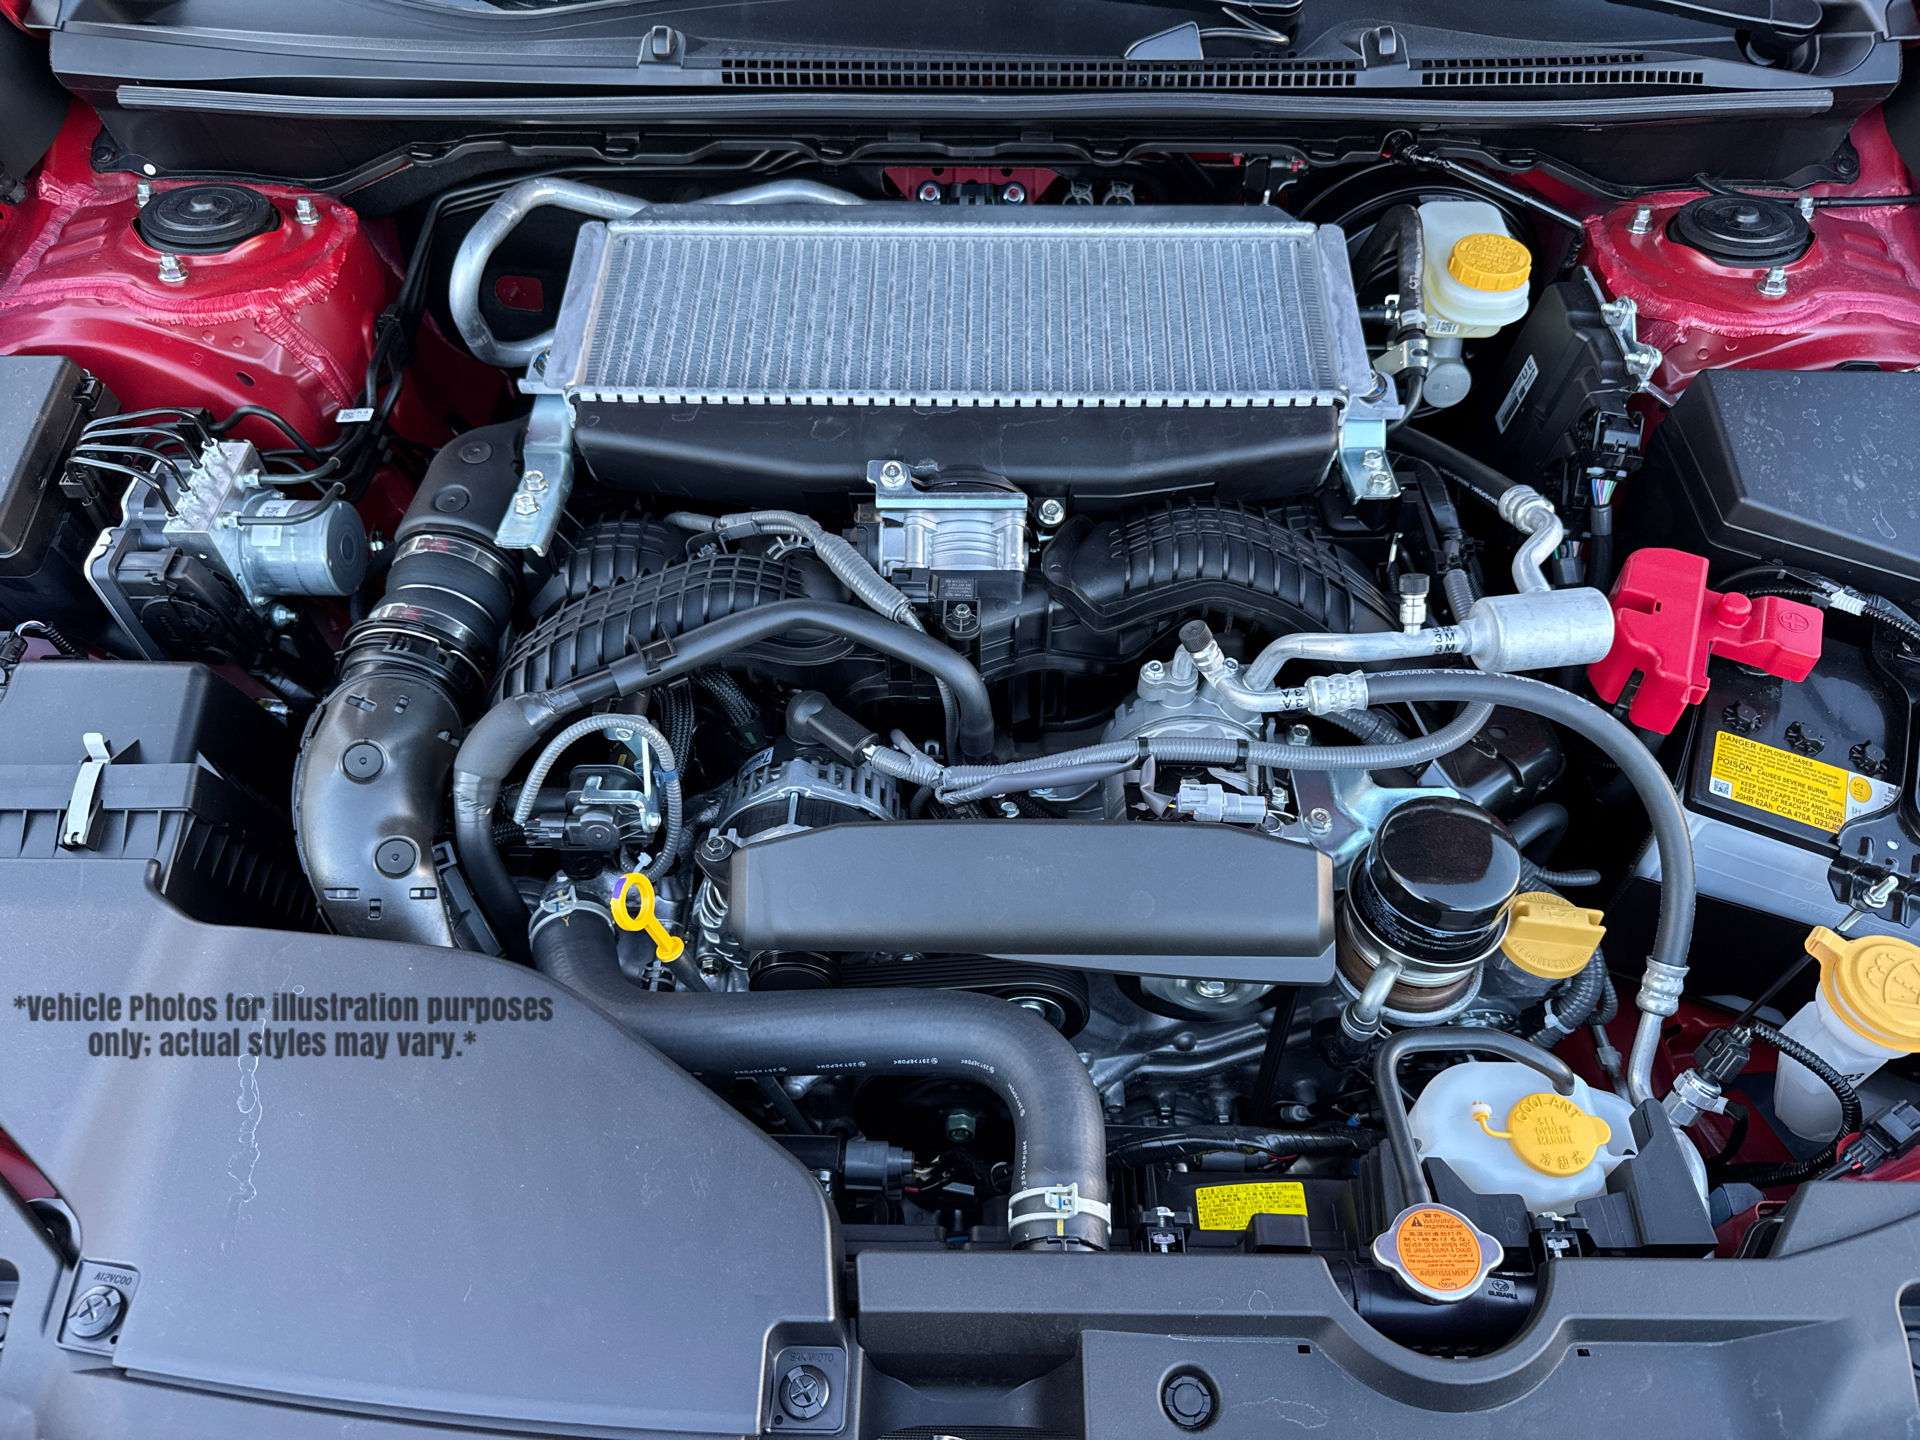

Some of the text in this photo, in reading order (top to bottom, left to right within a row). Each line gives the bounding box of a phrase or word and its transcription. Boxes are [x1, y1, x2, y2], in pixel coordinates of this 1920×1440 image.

[1378, 669, 1435, 678] YOKOHAMA
[1720, 733, 1813, 767] DANGER EXPLOSIVE GASES
[1717, 756, 1828, 796] POISON CAUSES SEVERE BURNS
[1735, 792, 1754, 803] 20HR
[1755, 799, 1773, 809] 62Ah
[1777, 805, 1792, 816] CCA
[1794, 810, 1811, 822] 470A
[1741, 780, 1756, 789] KEEP
[1758, 785, 1774, 794] VENT
[1775, 791, 1790, 800] CAPS
[1793, 797, 1810, 806] TIGHT
[1811, 803, 1823, 811] AND
[1825, 807, 1844, 818] LEVEL
[1757, 792, 1769, 800] OUT
[1781, 800, 1801, 810] REACH
[1812, 809, 1842, 823] CHILDREN
[1511, 941, 1526, 955] SEE
[1560, 950, 1588, 969] MANUAL
[1516, 1095, 1583, 1122] COOLANT
[1538, 1117, 1556, 1126] SEE
[1538, 1135, 1574, 1145] MANUAL
[1488, 1290, 1518, 1299] SUBARU
